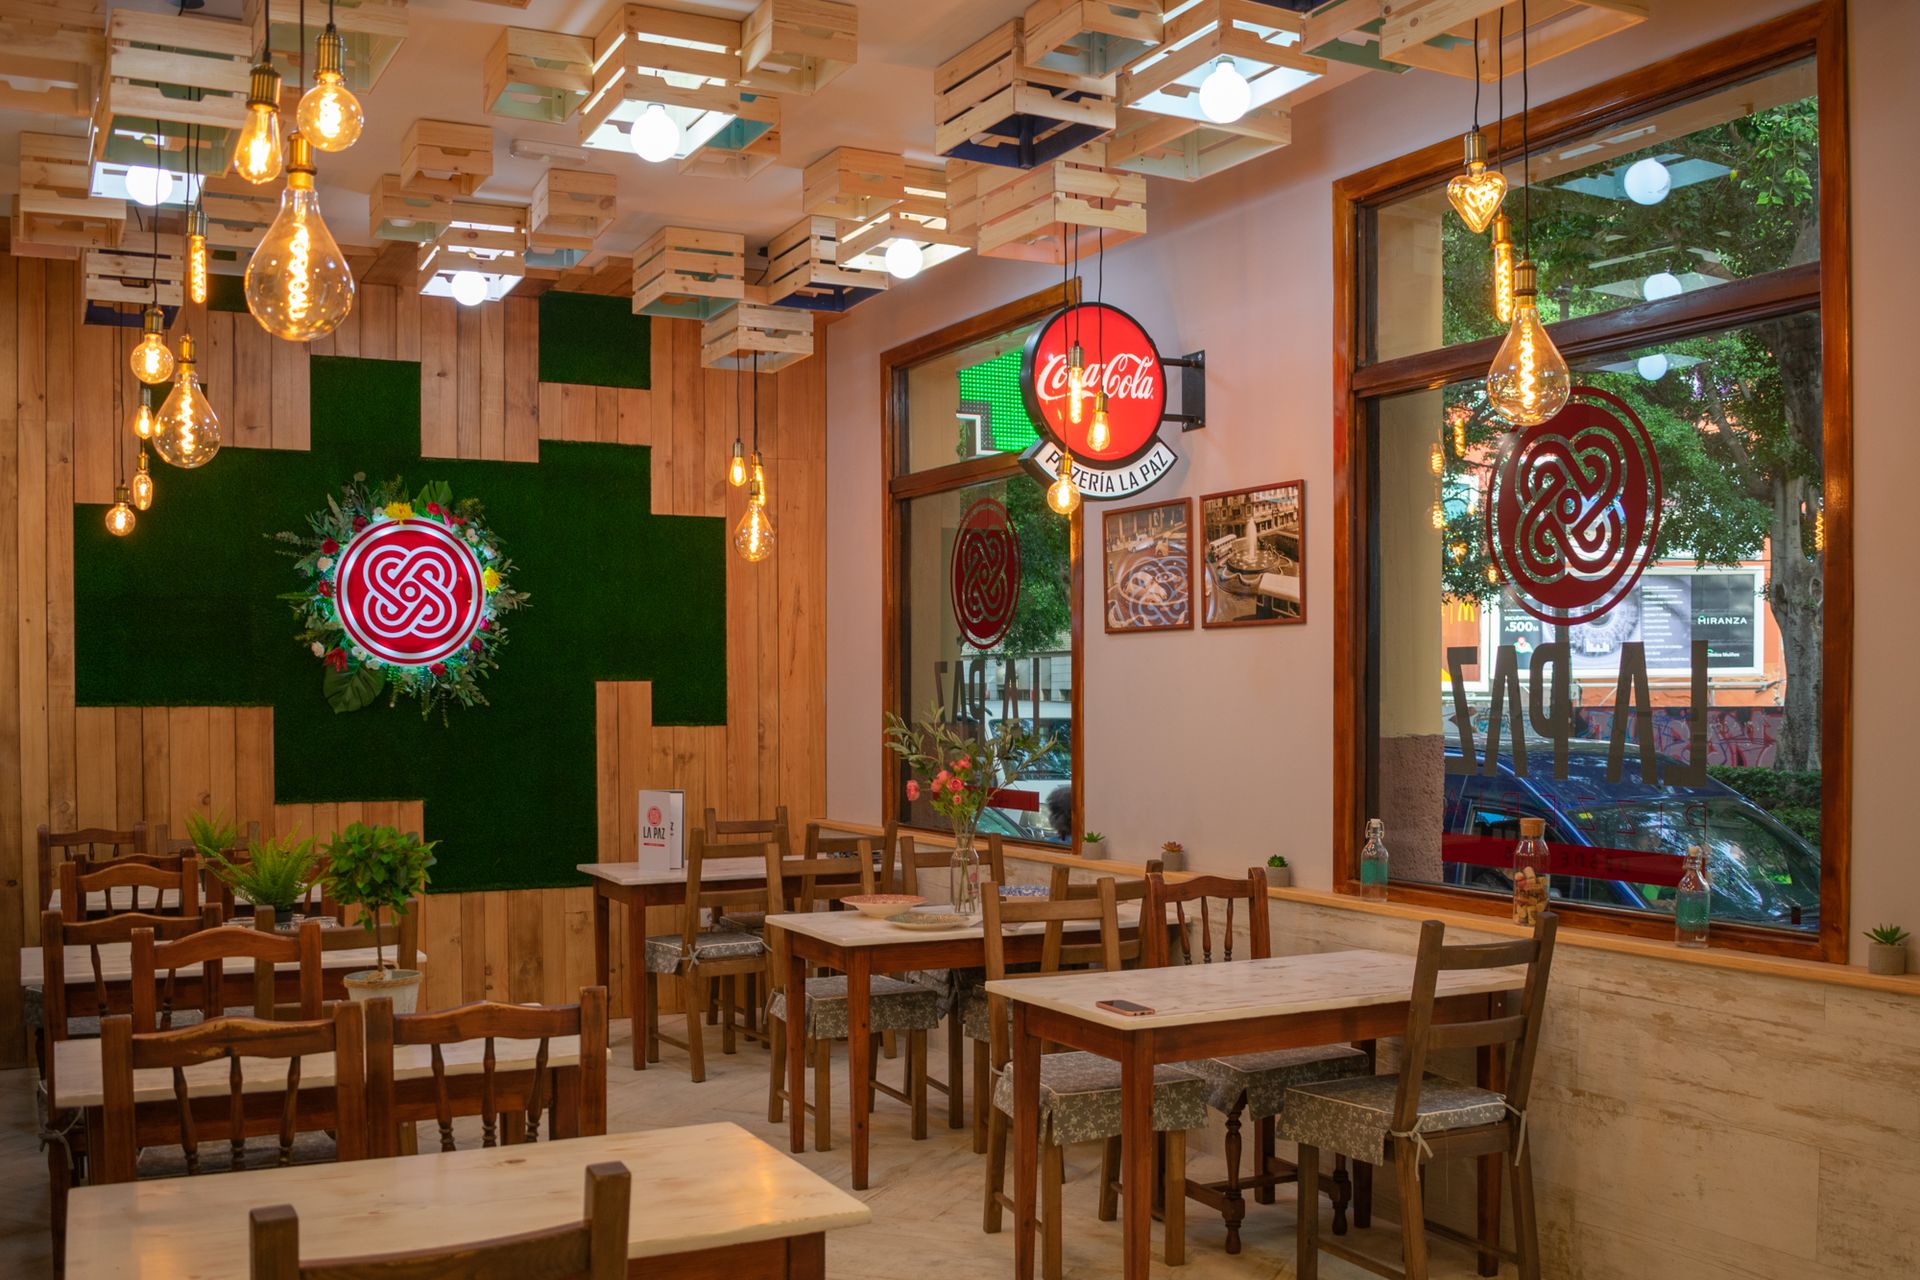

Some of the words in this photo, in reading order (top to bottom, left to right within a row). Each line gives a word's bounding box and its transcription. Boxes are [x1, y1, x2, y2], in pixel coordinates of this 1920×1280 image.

[1037, 353, 1154, 401] Coa-Cola
[1046, 450, 1115, 493] PZERÍA
[1119, 471, 1139, 491] LA
[1139, 450, 1169, 482] PAZ
[643, 827, 652, 839] LA
[653, 827, 666, 840] PAZ
